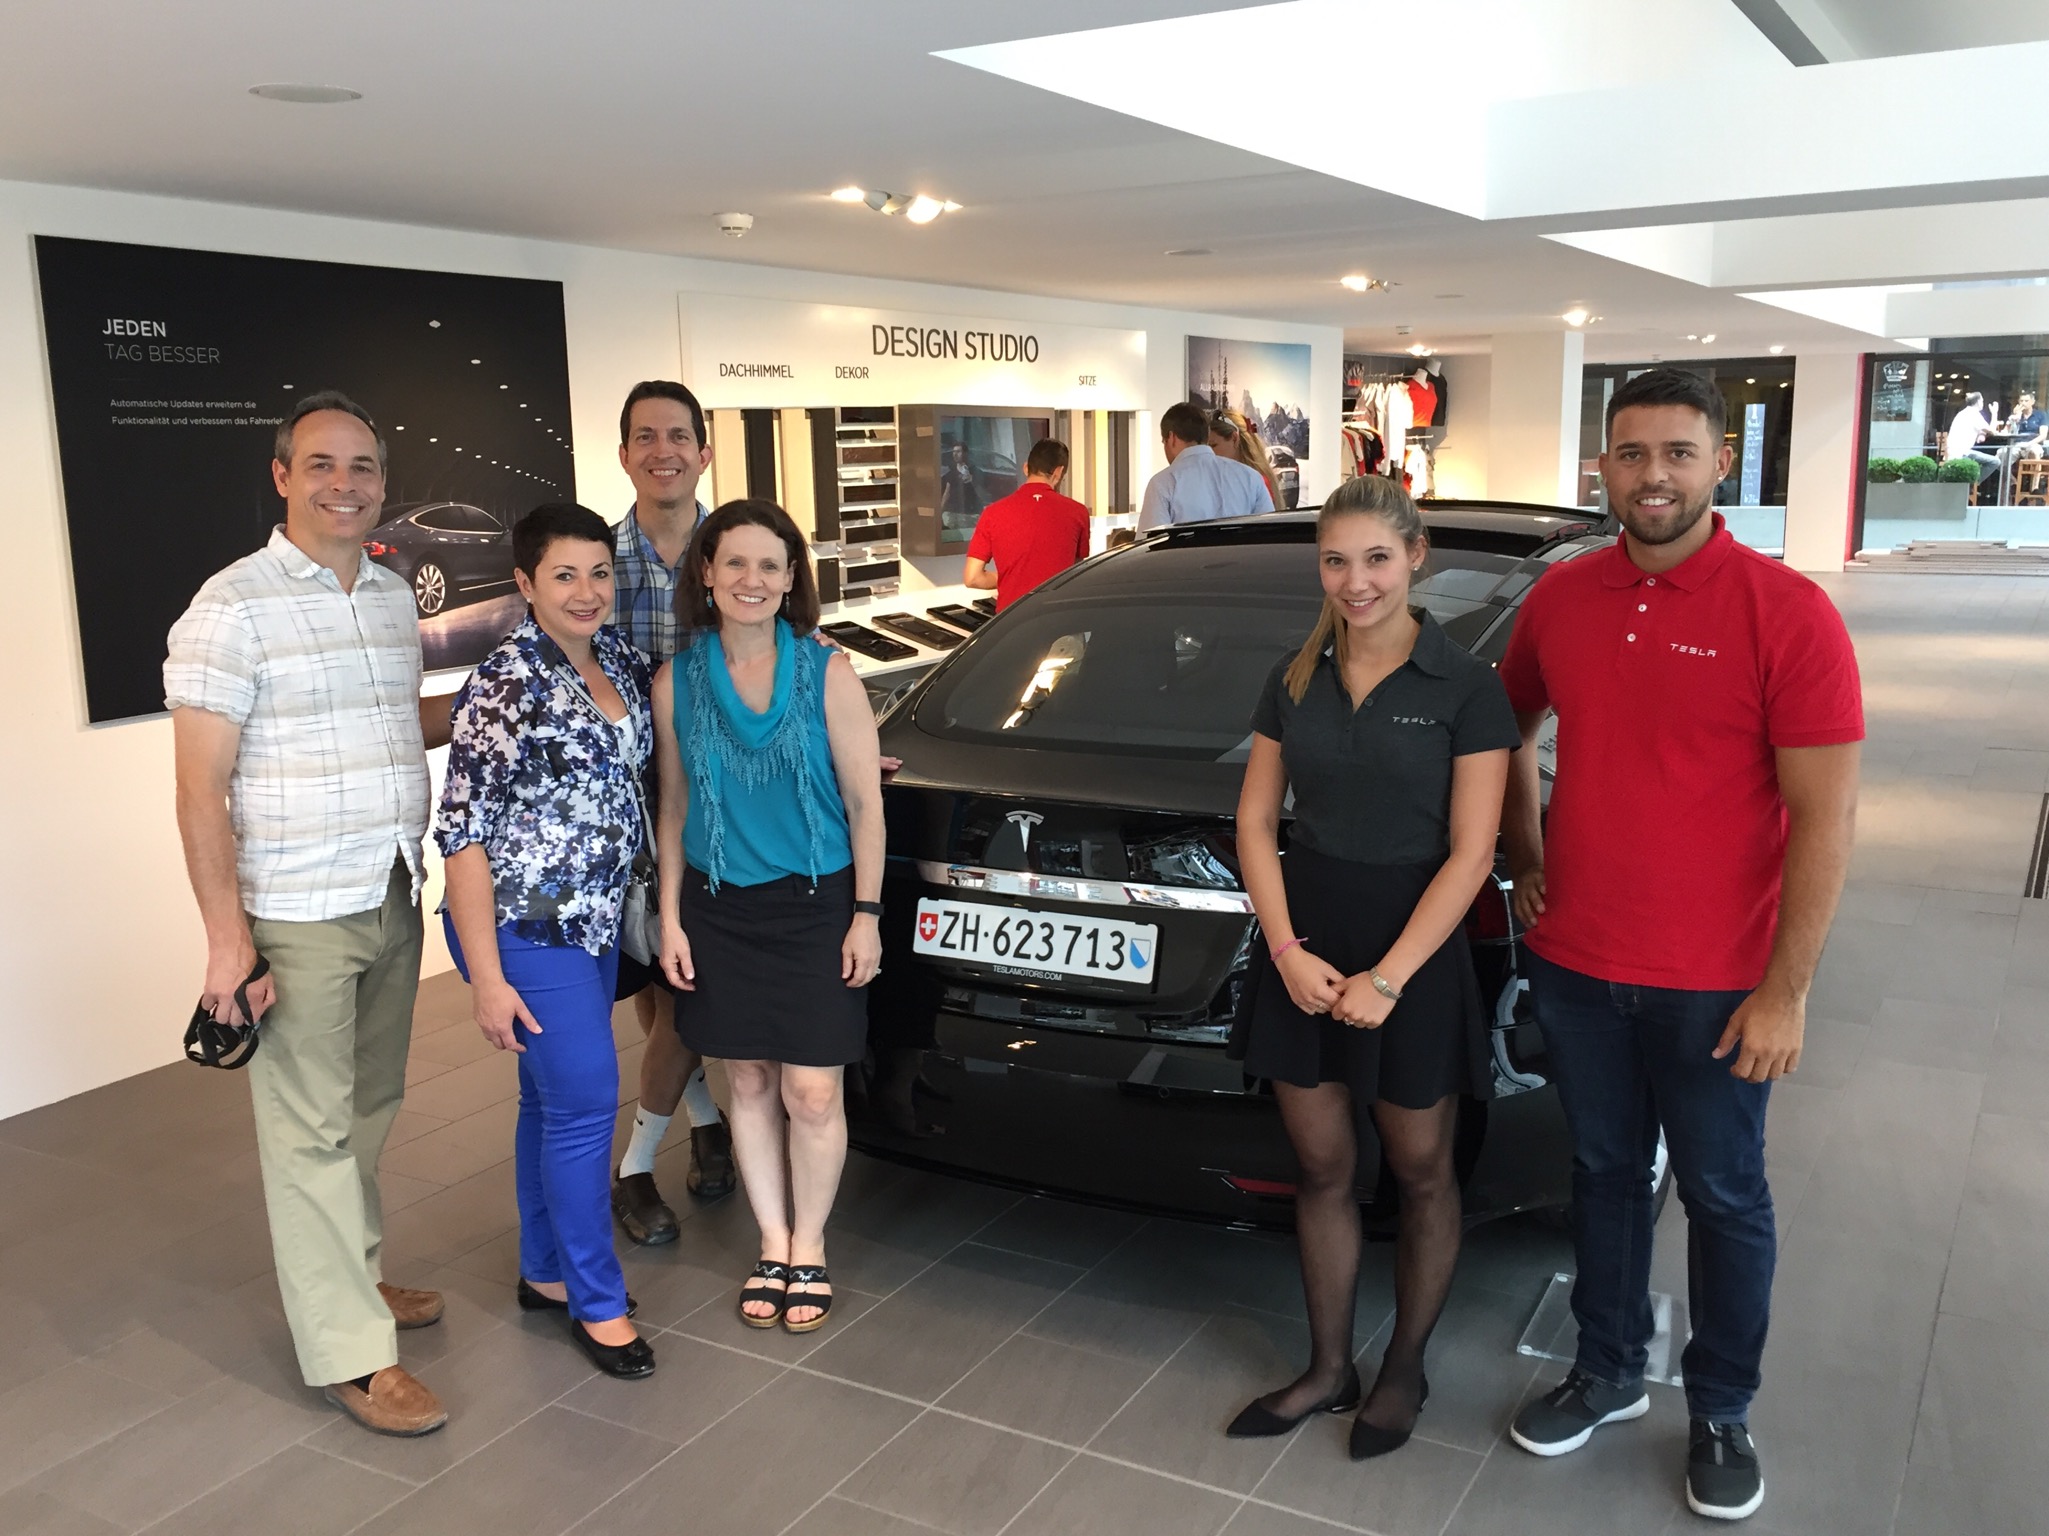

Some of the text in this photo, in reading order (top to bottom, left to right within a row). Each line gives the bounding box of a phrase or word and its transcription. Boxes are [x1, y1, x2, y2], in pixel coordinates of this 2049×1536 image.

[102, 318, 167, 338] JEDEN
[872, 324, 1040, 363] DESIGN STUDIO
[104, 343, 220, 364] TAG BESSER
[719, 362, 795, 379] DACHHIMMEL
[835, 366, 870, 380] DEKOR
[1078, 375, 1098, 387] SITZE
[110, 399, 257, 409] Automatische Updates erweitern die
[112, 416, 170, 425] Funktionalität
[171, 417, 188, 425] und
[190, 417, 233, 425] verbessern
[234, 417, 248, 425] das
[1669, 642, 1717, 658] TESLA
[1392, 715, 1437, 726] TESLA
[993, 965, 1063, 981] TESLAMOTORS.COM
